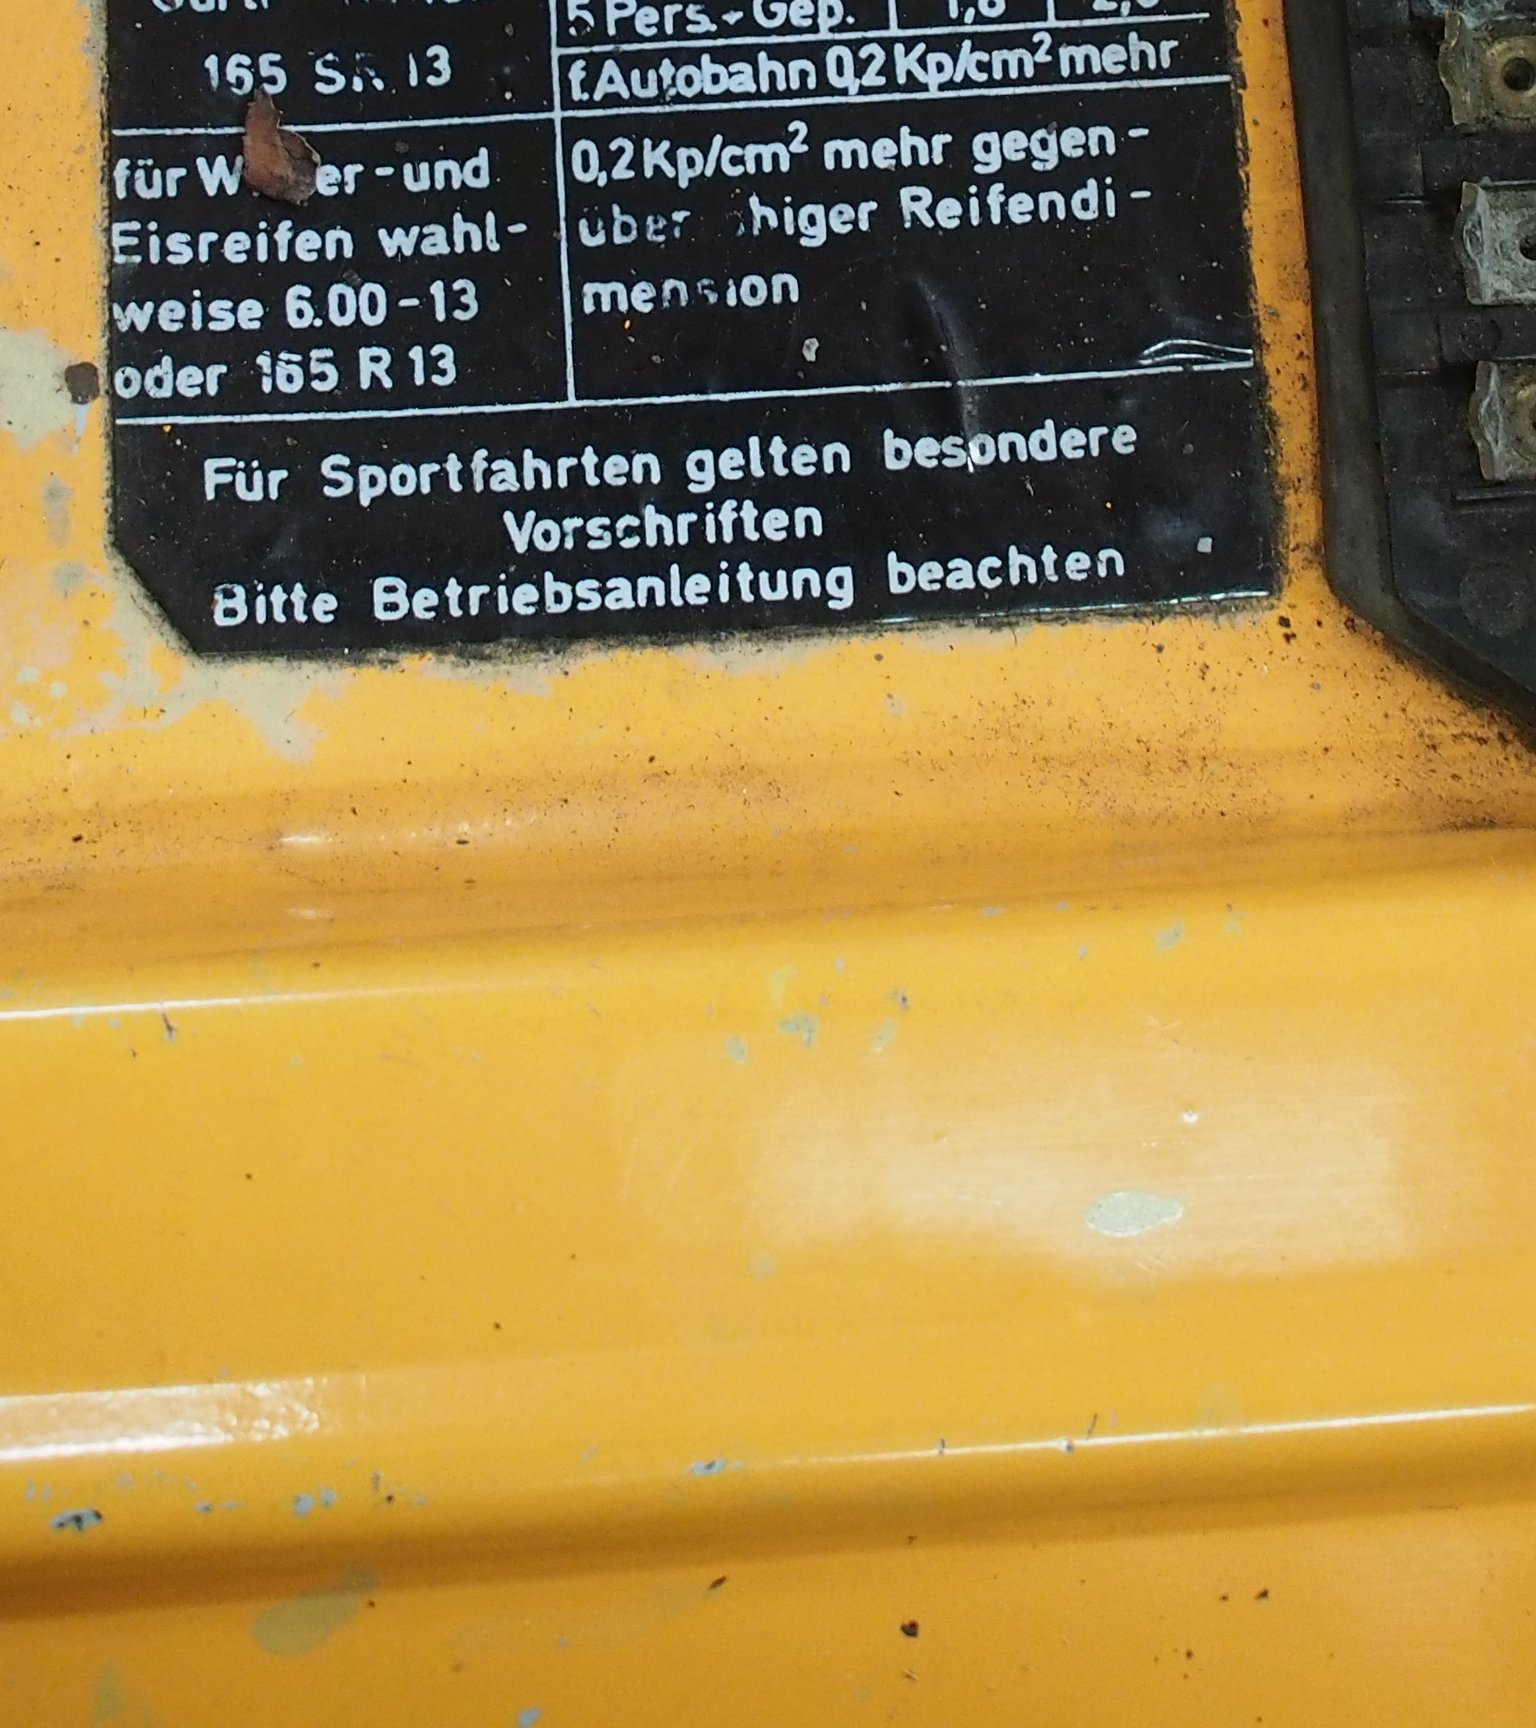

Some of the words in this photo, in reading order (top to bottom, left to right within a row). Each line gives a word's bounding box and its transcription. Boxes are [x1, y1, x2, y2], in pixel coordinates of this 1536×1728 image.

[199, 47, 289, 98] 165
[409, 45, 451, 86] 13
[1059, 32, 1178, 77] mehr
[824, 126, 952, 170] mehr
[112, 156, 188, 202] für
[110, 217, 356, 270] Eisreifen
[112, 292, 266, 336] weise
[580, 272, 802, 317] mension
[112, 352, 230, 400] oder
[256, 348, 338, 393] 165
[359, 347, 392, 390] R
[409, 344, 456, 386] 13
[204, 458, 288, 501] Für
[321, 446, 660, 507] Sportfahrten
[686, 436, 850, 493] gelten
[884, 419, 1136, 473] besondere
[503, 500, 822, 553] Vorschriften
[213, 583, 337, 626] Bitte
[373, 562, 853, 621] Betriebsanleitung
[888, 545, 1124, 594] beachten
